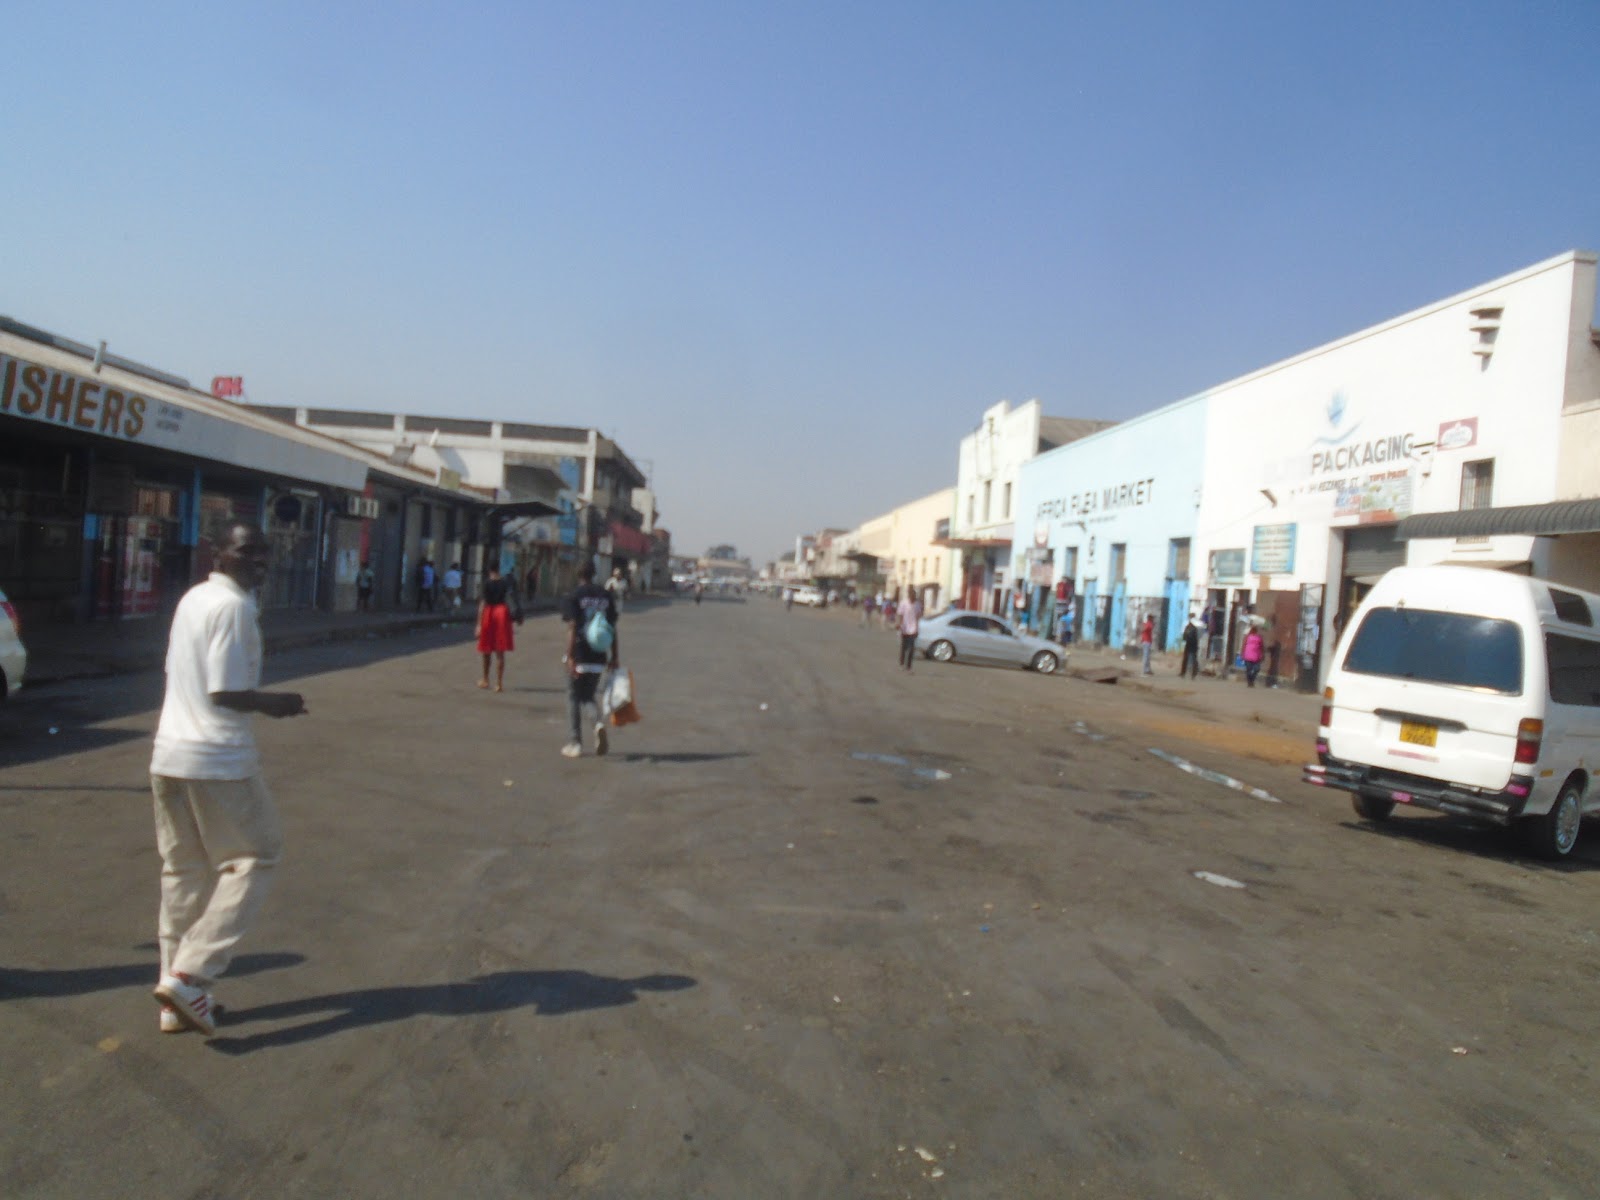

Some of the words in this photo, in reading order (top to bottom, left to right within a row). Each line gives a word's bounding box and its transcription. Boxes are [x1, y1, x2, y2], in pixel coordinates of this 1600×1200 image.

[1, 360, 146, 437] ISHERS
[1311, 433, 1413, 474] PACKAGING
[1103, 478, 1154, 510] MARKET
